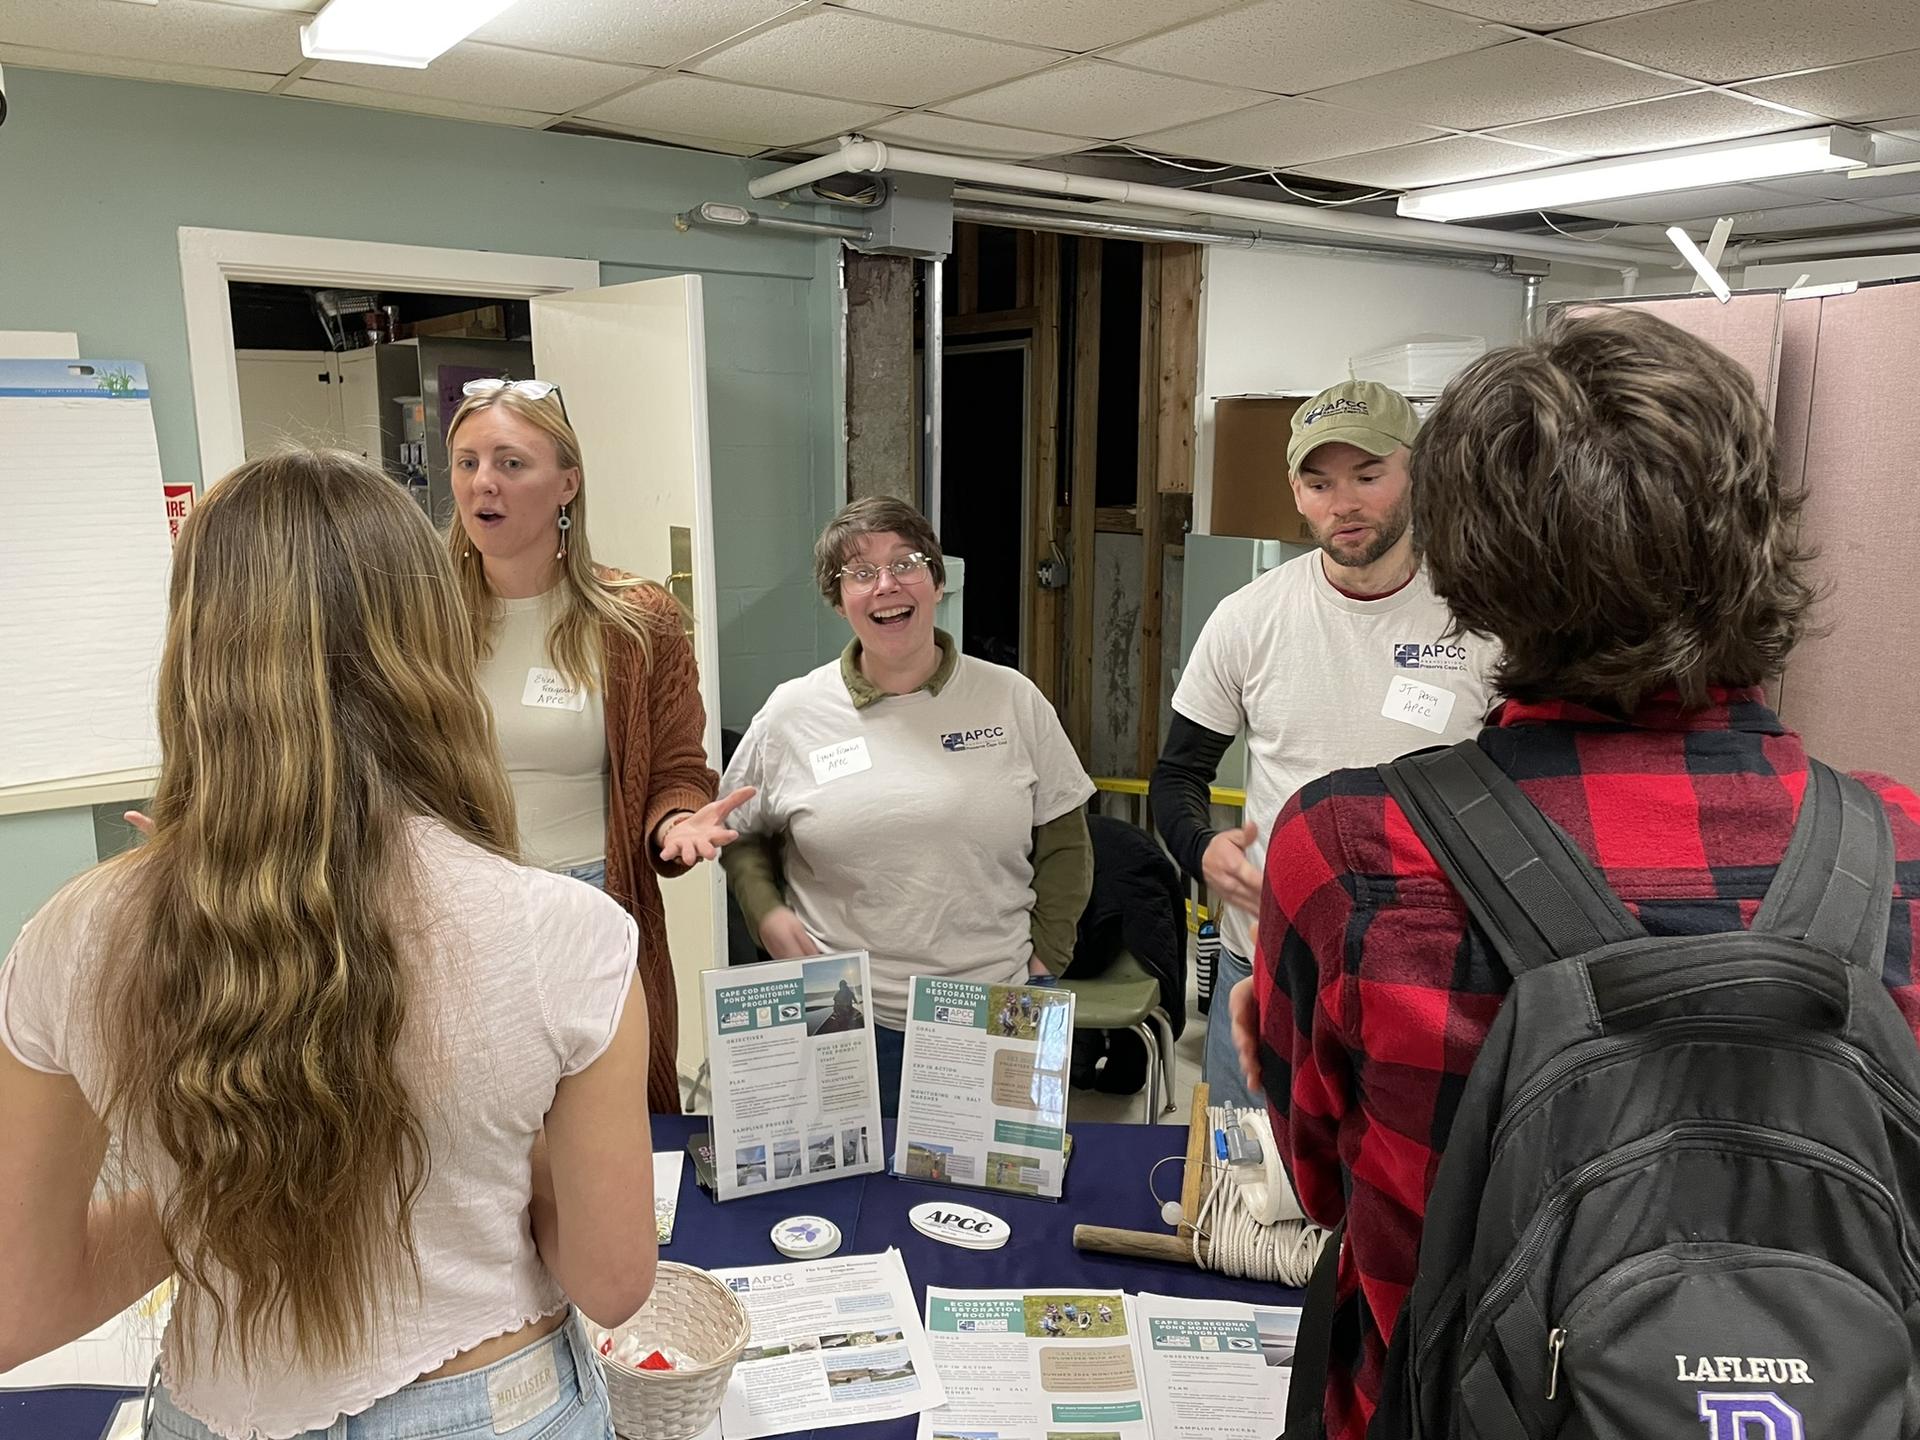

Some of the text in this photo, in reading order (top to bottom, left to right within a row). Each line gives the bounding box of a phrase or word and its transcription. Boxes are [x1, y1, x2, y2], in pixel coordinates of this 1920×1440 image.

[1324, 398, 1367, 411] APCC
[167, 501, 186, 517] IRE
[1422, 644, 1466, 660] APCC
[1400, 684, 1418, 695] JT
[1403, 701, 1432, 717] APCC
[965, 726, 1004, 742] APCC
[720, 982, 799, 998] CAPE COD REGIONAL
[926, 988, 987, 1001] RESTORATION
[930, 981, 983, 993] ECOSYSTEM
[724, 989, 796, 1004] POND MONITORING
[742, 998, 779, 1008] PROGRAM
[934, 996, 977, 1008] PROGRAM
[950, 1008, 974, 1019] APCC
[926, 1210, 993, 1234] APCC
[752, 1272, 793, 1285] APCC
[1675, 1355, 1815, 1384] LAFLEUR
[497, 1368, 551, 1405] HOLLISTER
